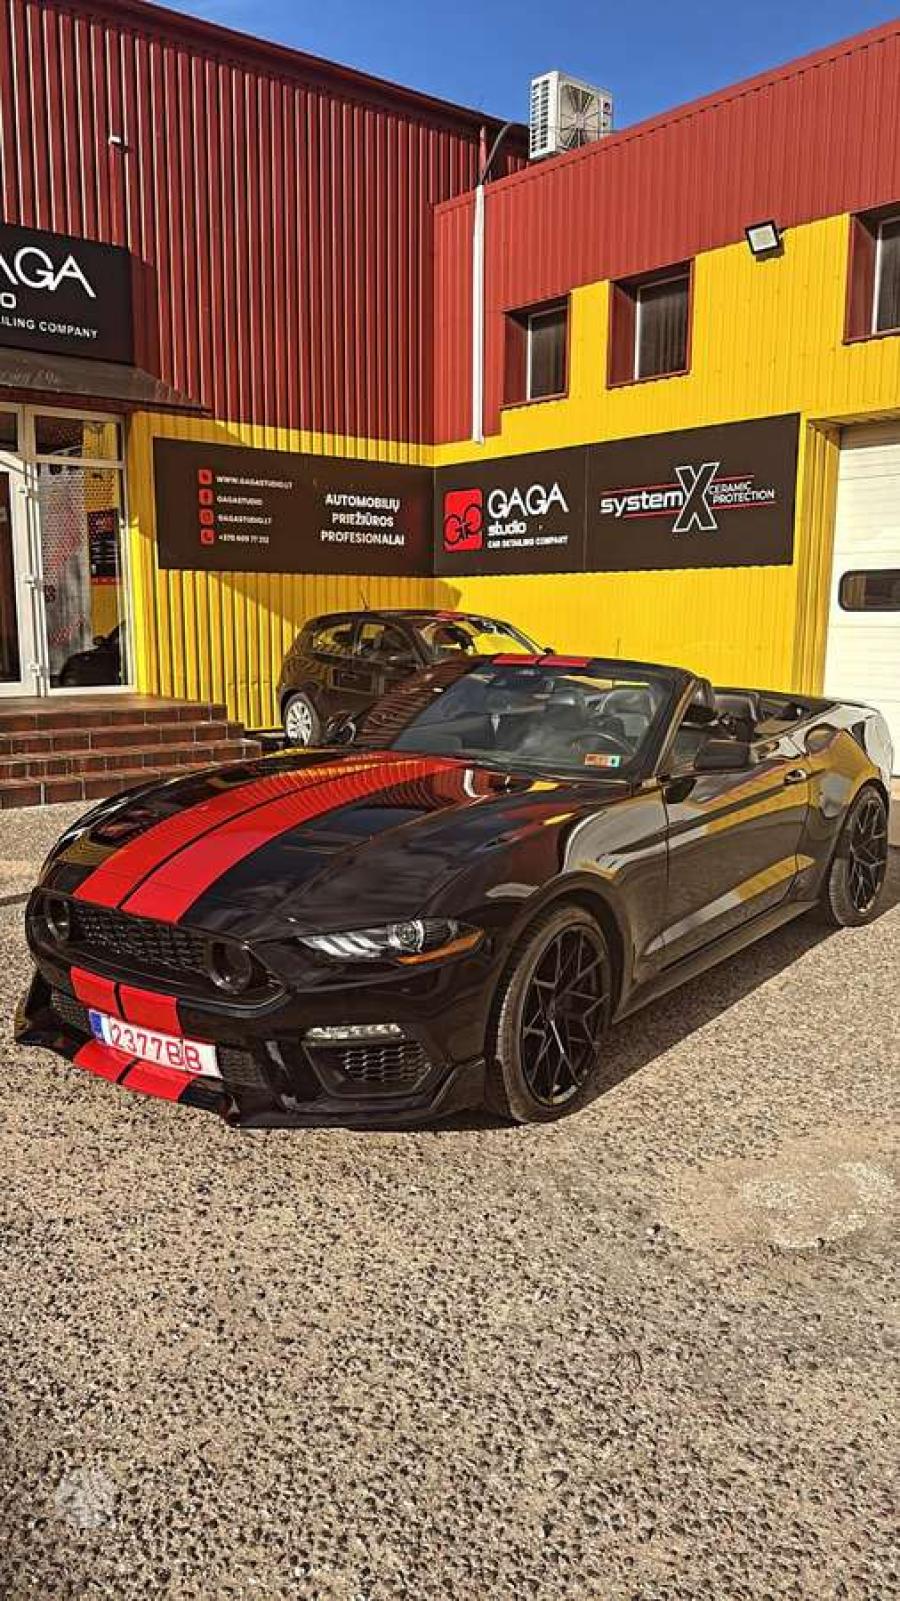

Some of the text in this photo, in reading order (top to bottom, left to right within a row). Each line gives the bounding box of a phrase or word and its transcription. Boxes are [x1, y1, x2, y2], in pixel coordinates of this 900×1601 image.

[39, 321, 98, 338] COMPANY
[709, 481, 752, 496] CERAMIC
[712, 488, 775, 505] PROTECTION
[324, 492, 401, 513] AUTOMOBILIŲ
[487, 481, 569, 519] GAGA
[331, 511, 394, 528] PRIEŽIŪROS
[487, 520, 527, 536] studio
[321, 529, 405, 546] PROFESIONALAI
[487, 534, 568, 549] CAR DETAILING COMPANY
